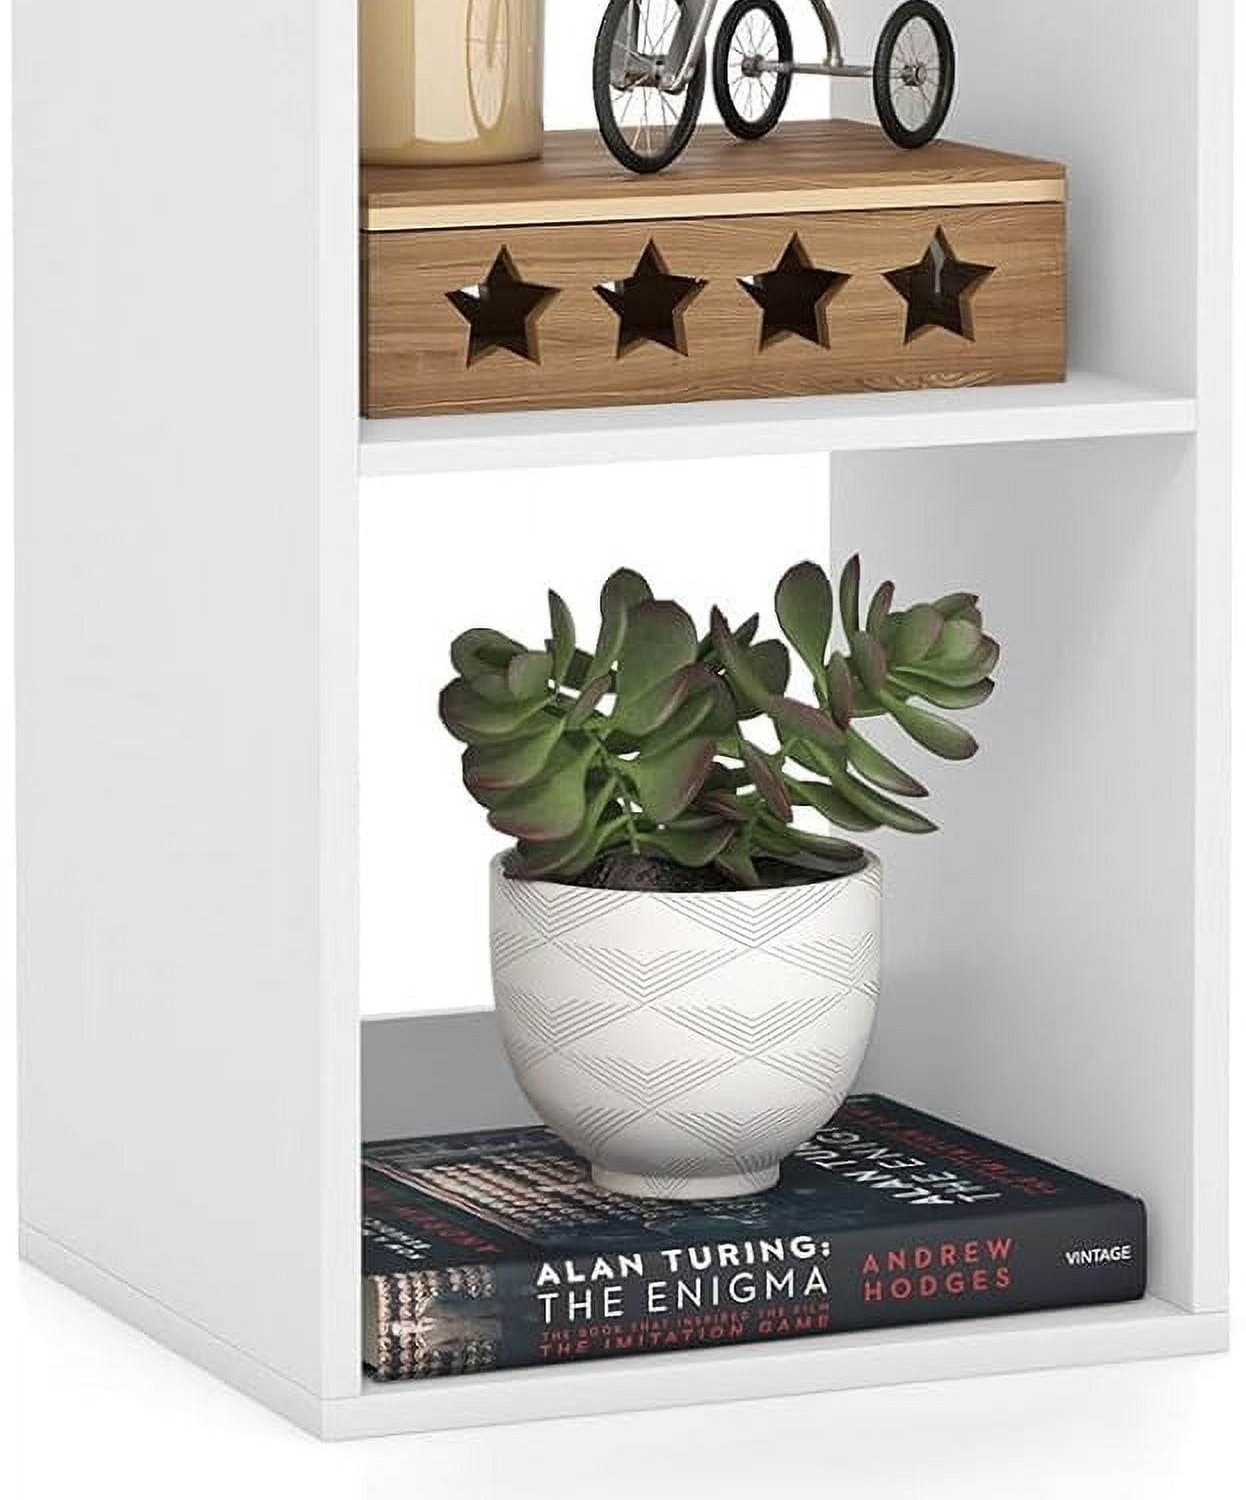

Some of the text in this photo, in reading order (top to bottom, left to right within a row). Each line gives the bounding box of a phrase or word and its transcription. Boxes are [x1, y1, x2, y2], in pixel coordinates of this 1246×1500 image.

[816, 1127, 927, 1170] ENIG
[910, 1171, 1002, 1203] THE
[536, 1235, 831, 1286] ALAN TURING:
[862, 1237, 1014, 1274] ANDREW
[1064, 1244, 1132, 1266] VINTAGE
[537, 1267, 829, 1324] THE ENIGMA
[863, 1267, 1012, 1301] HODGES
[540, 1340, 590, 1357] THE
